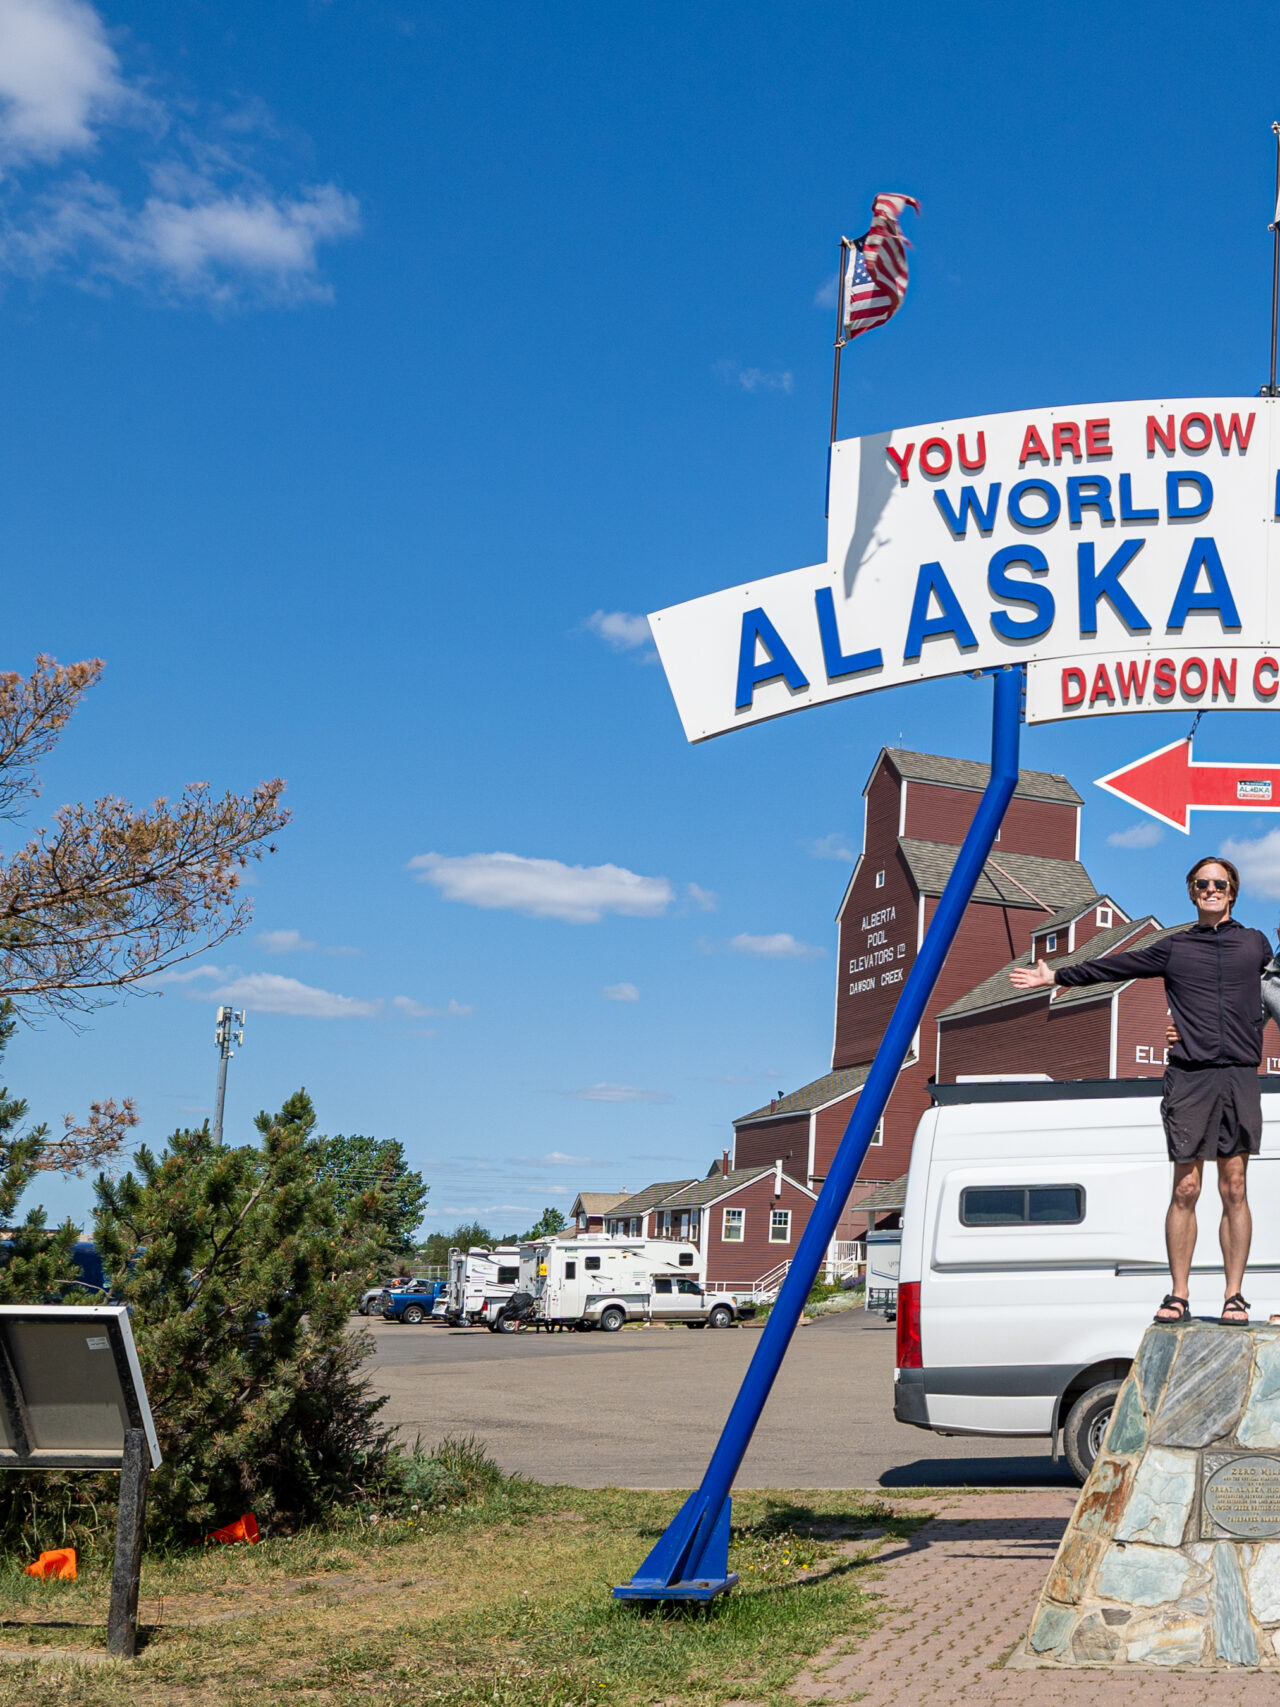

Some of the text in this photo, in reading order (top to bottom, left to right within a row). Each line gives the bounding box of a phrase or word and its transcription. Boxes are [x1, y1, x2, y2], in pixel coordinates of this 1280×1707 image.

[886, 430, 987, 482] YOU
[1019, 418, 1113, 463] ARE
[1147, 412, 1256, 453] NOW
[934, 470, 1214, 535] WORLD
[735, 537, 1242, 710] ALASKA
[1061, 657, 1238, 706] DAWSON
[861, 906, 895, 931] ALBERTA
[867, 930, 888, 948] POOL
[849, 947, 894, 974] ELEVATORS
[849, 968, 904, 995] DAWSON CREEK
